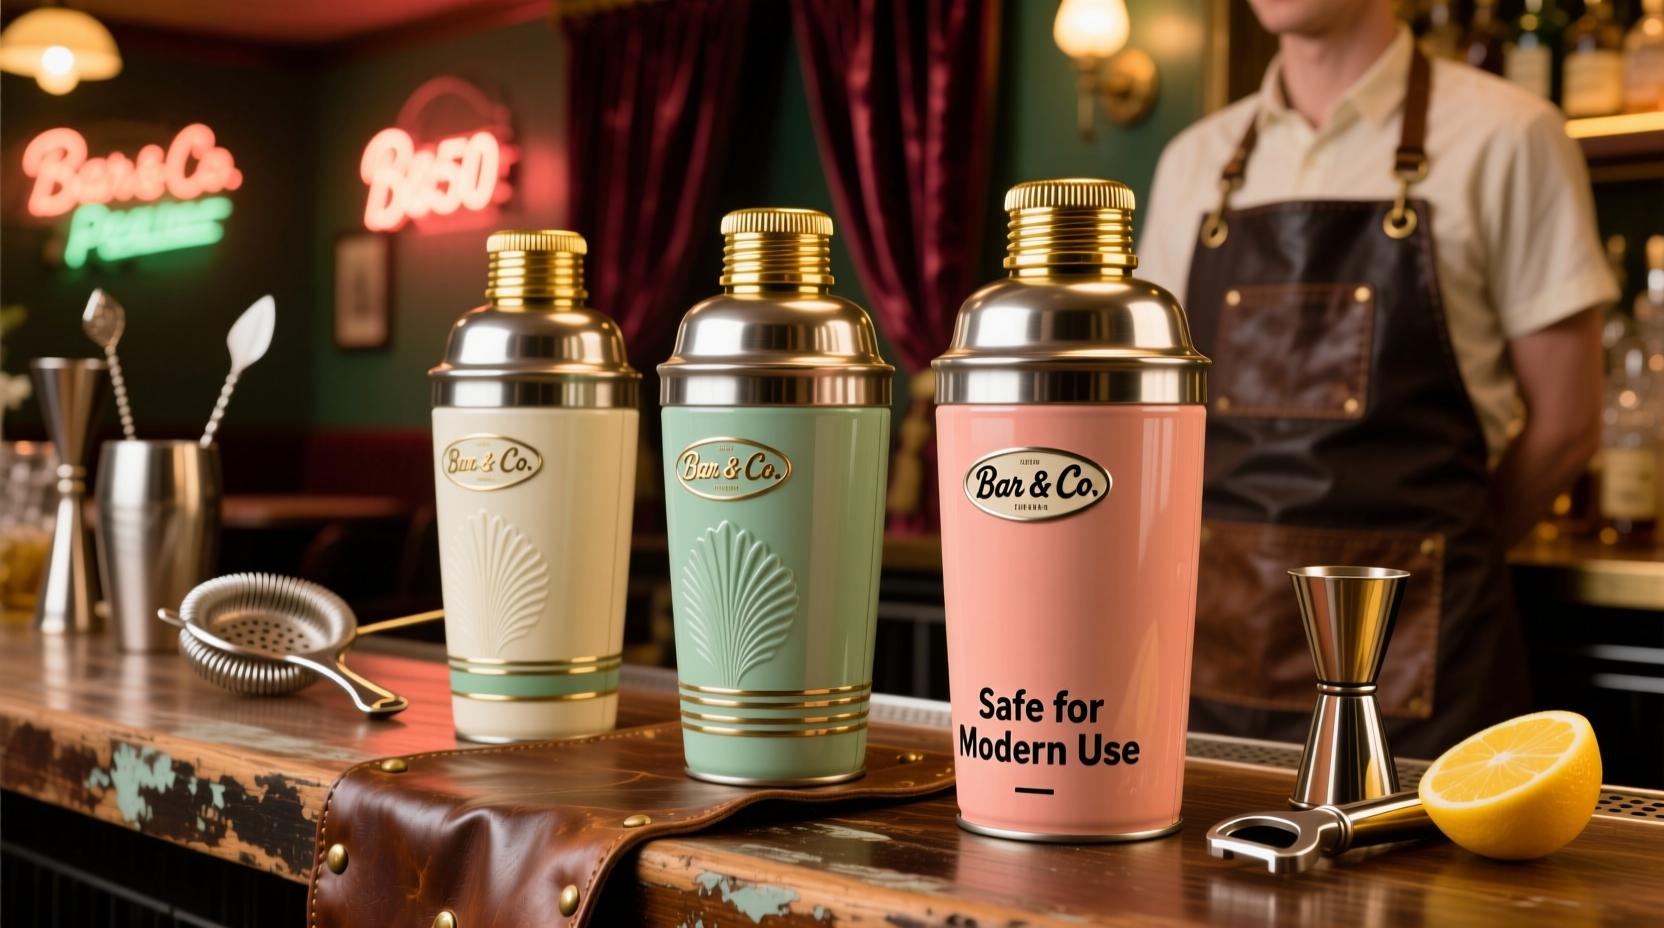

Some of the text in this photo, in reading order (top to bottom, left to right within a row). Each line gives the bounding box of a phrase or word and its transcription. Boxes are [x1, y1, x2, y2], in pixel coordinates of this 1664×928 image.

[480, 452, 496, 473] &
[500, 447, 532, 473] Co.
[723, 456, 742, 480] &
[744, 452, 781, 481] Co.
[976, 464, 1098, 499] Bar & Co.
[979, 687, 1105, 723] Safe for
[959, 724, 1141, 766] Modern Use
